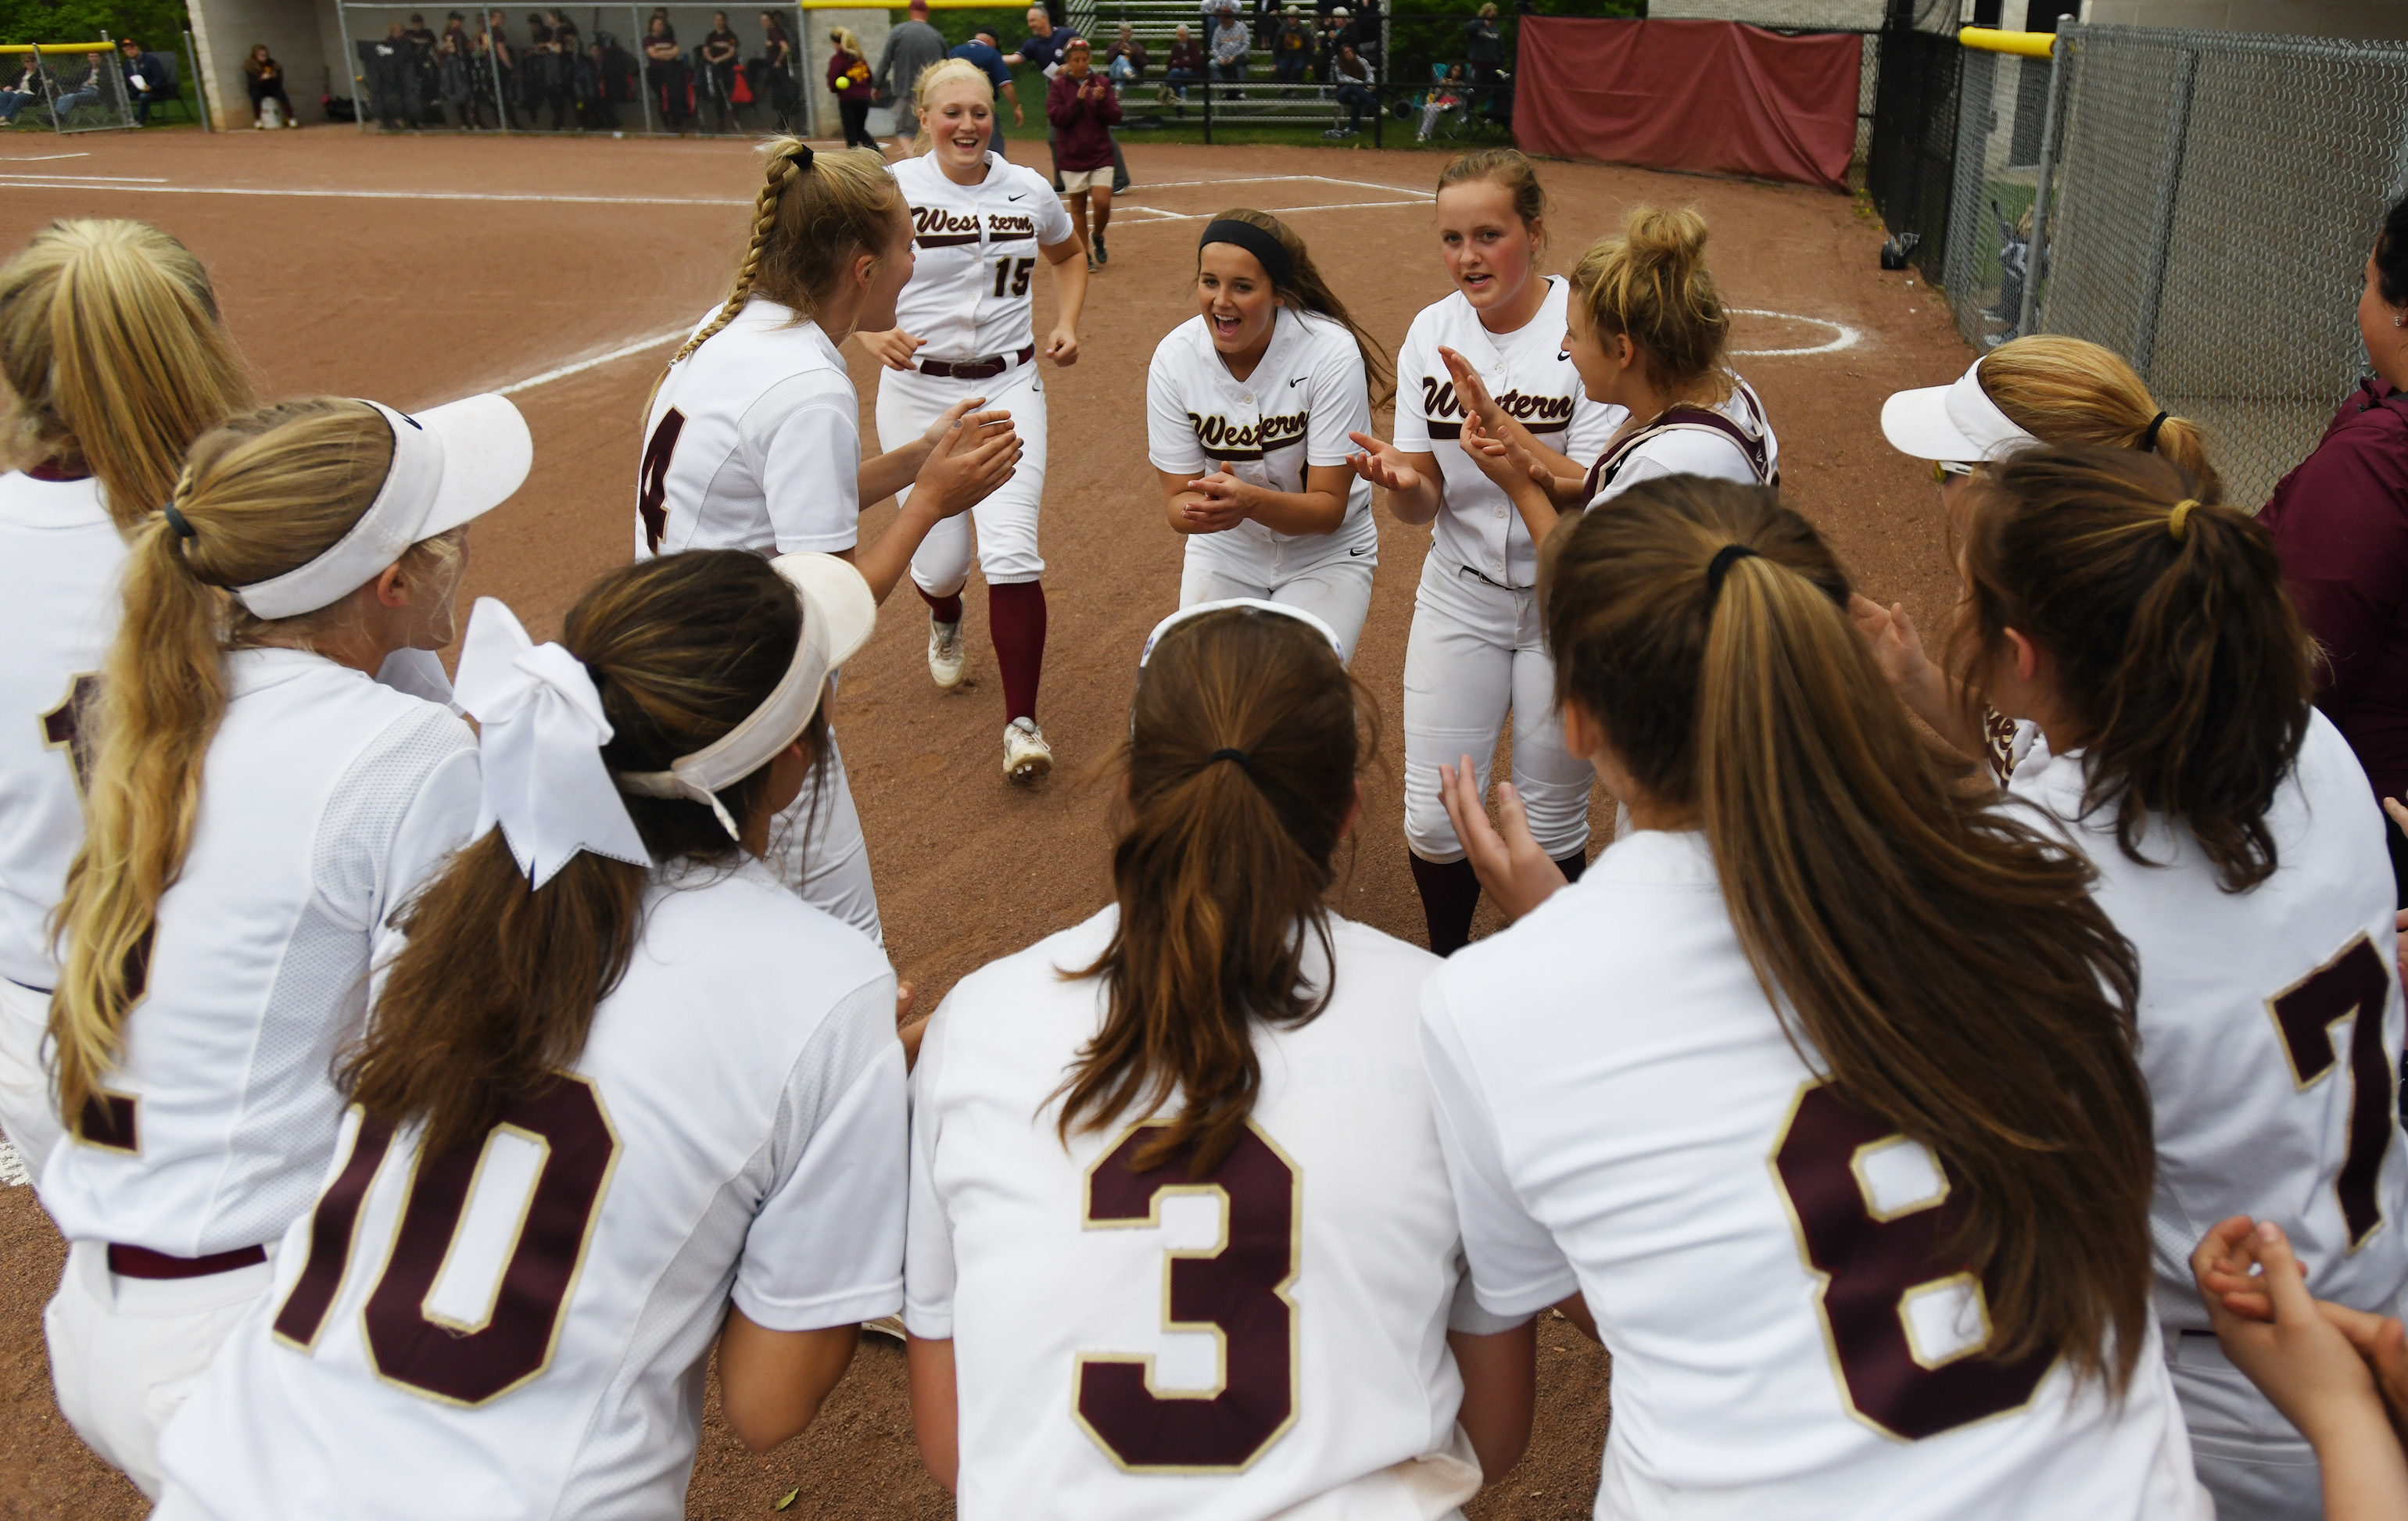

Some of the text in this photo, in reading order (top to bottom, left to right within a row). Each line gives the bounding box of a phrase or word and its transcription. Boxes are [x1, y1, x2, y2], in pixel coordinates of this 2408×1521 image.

[910, 206, 1035, 239] Western
[994, 255, 1036, 299] 15
[1188, 410, 1310, 452] Western
[1423, 376, 1574, 422] Wtern
[639, 403, 688, 557] 4
[2264, 930, 2395, 1257] 7
[273, 1069, 623, 1411] 10
[1070, 1118, 1303, 1476] 3
[1767, 1073, 2070, 1442] 8
